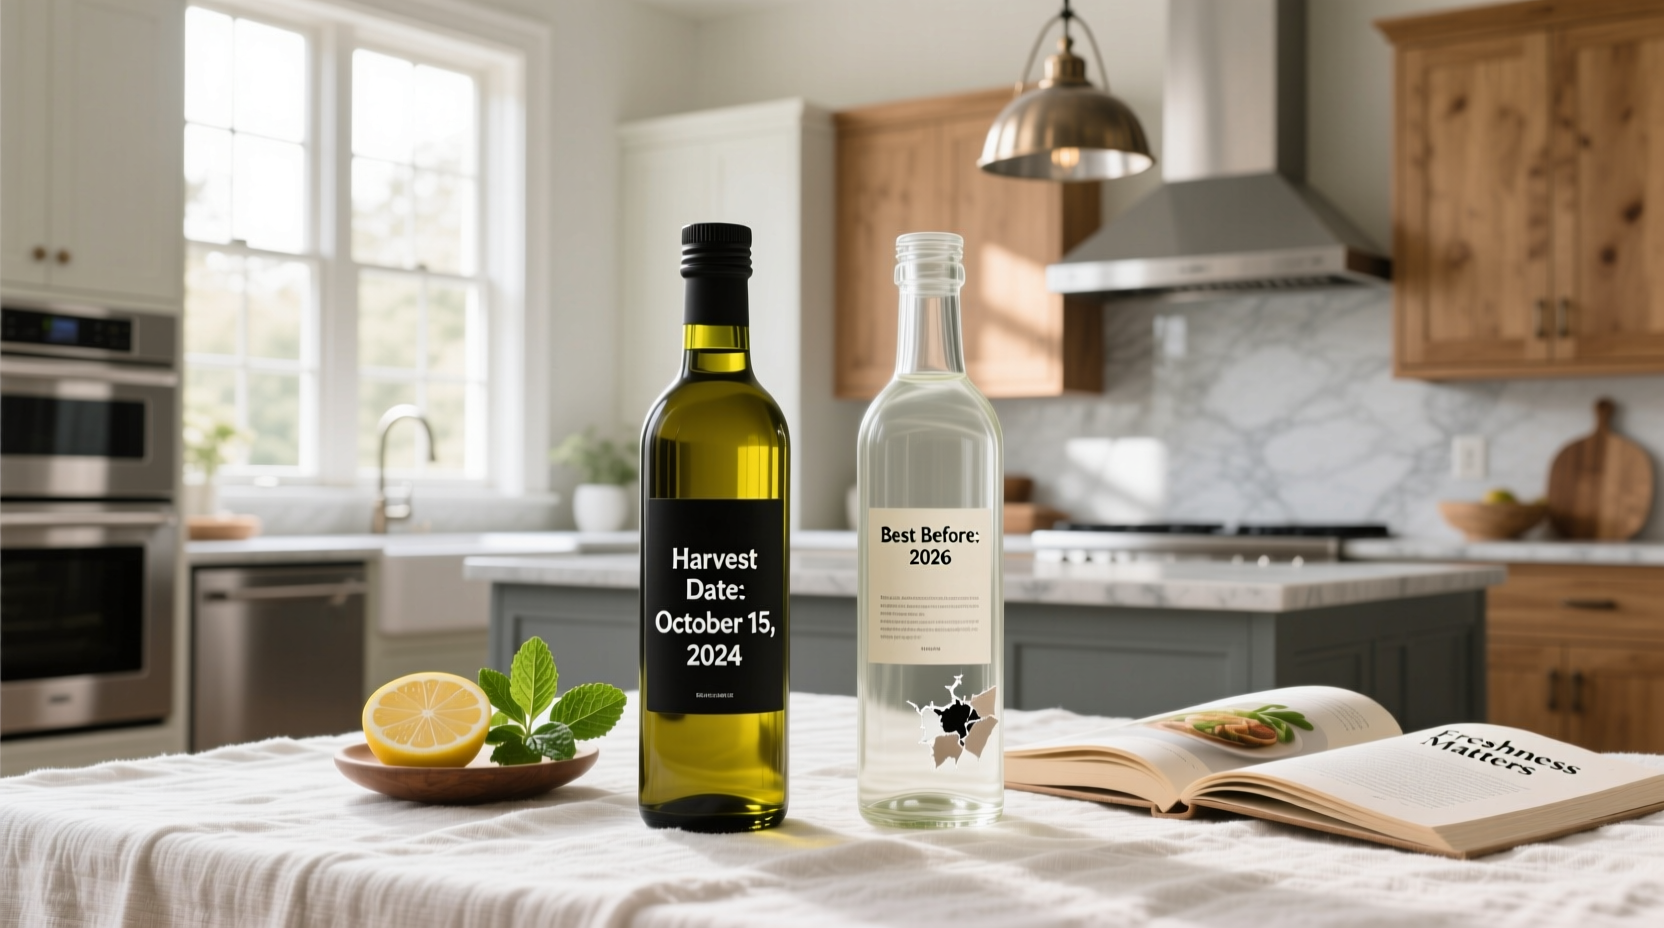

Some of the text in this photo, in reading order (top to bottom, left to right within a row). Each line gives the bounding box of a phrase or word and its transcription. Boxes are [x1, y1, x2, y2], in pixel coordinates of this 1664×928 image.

[881, 525, 980, 544] Best Before:
[672, 547, 758, 570] Harvest
[909, 548, 952, 565] 2026
[686, 578, 746, 600] Date:
[655, 610, 776, 638] October 15,
[686, 644, 743, 667] 2024
[1420, 736, 1537, 776] Matters
[1436, 729, 1582, 775] Freshness
